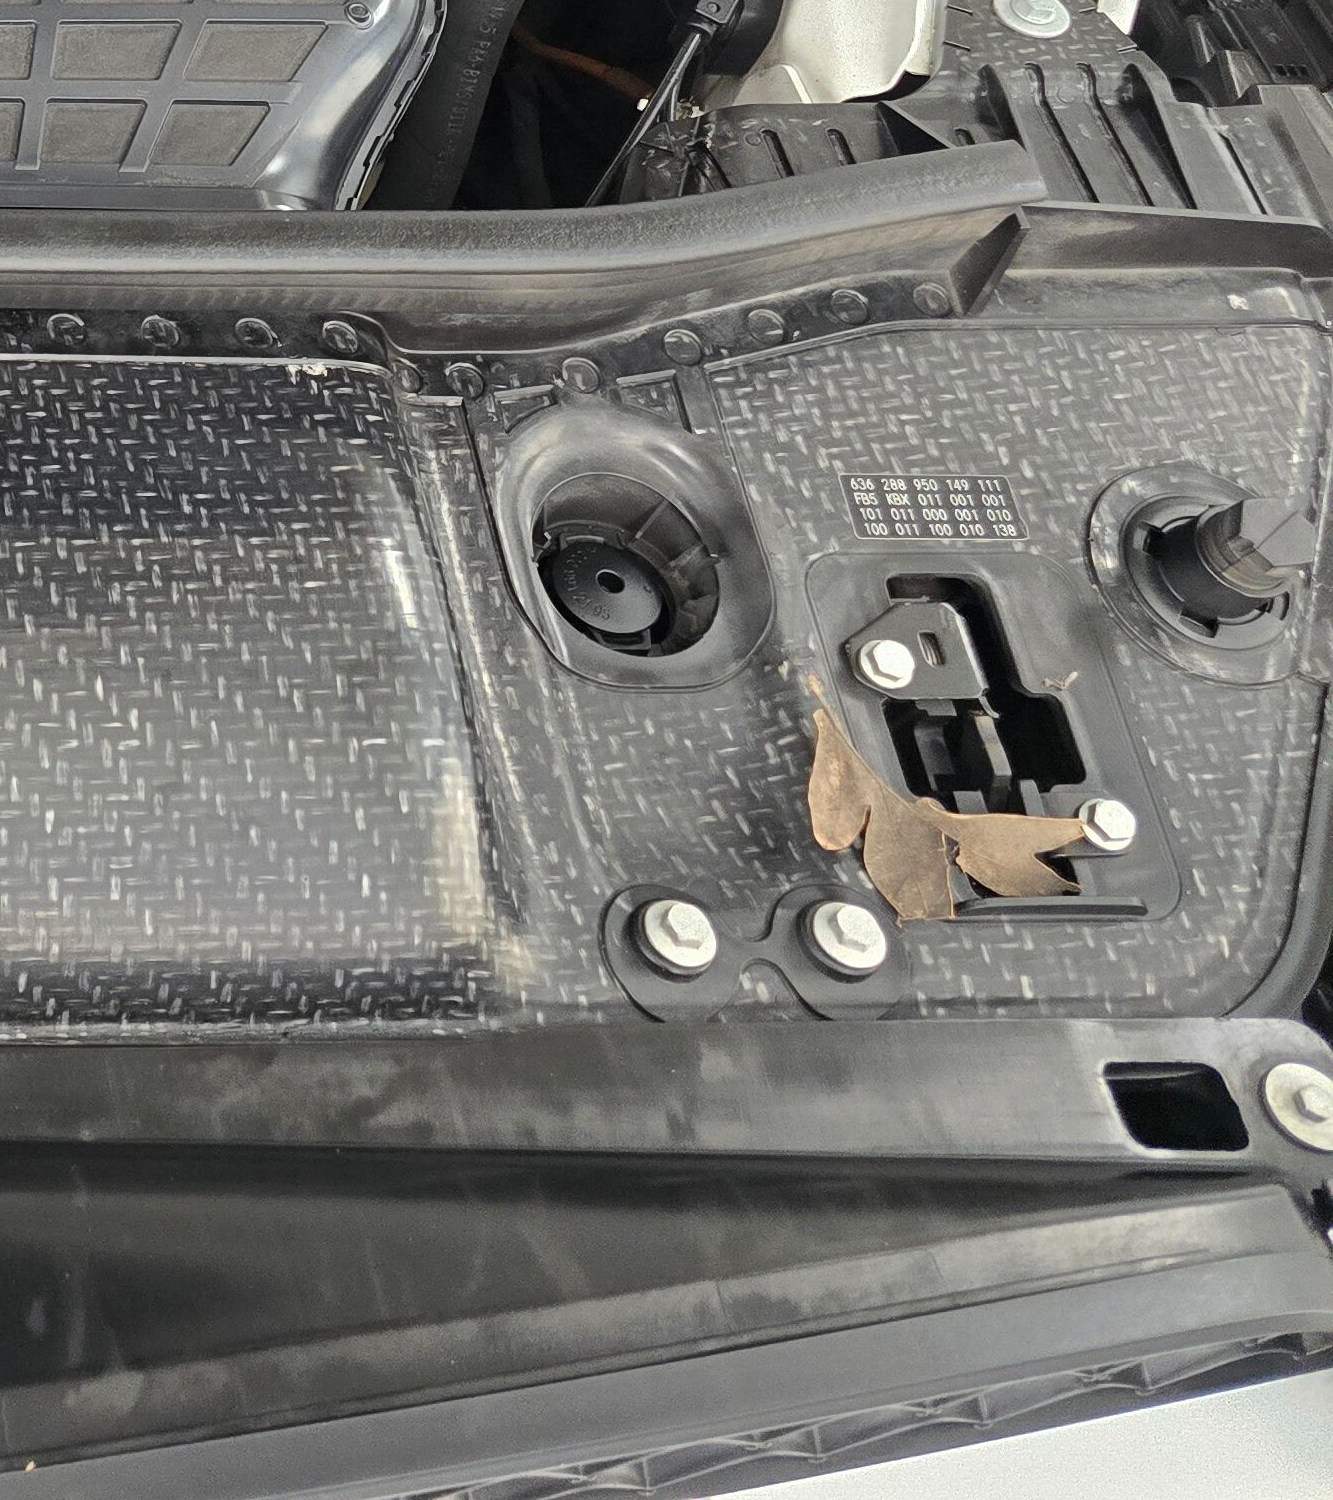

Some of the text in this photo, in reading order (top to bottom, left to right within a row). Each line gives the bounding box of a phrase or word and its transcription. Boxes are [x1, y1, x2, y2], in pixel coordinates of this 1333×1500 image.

[851, 478, 1001, 491] 636 288 950 149 111
[854, 493, 878, 506] FB5
[918, 494, 942, 506] 011
[950, 494, 974, 506] 001
[982, 495, 1006, 507] 001
[860, 507, 1011, 521] 101 011 000 001 010
[864, 523, 1017, 536] 100 011 100 010 138
